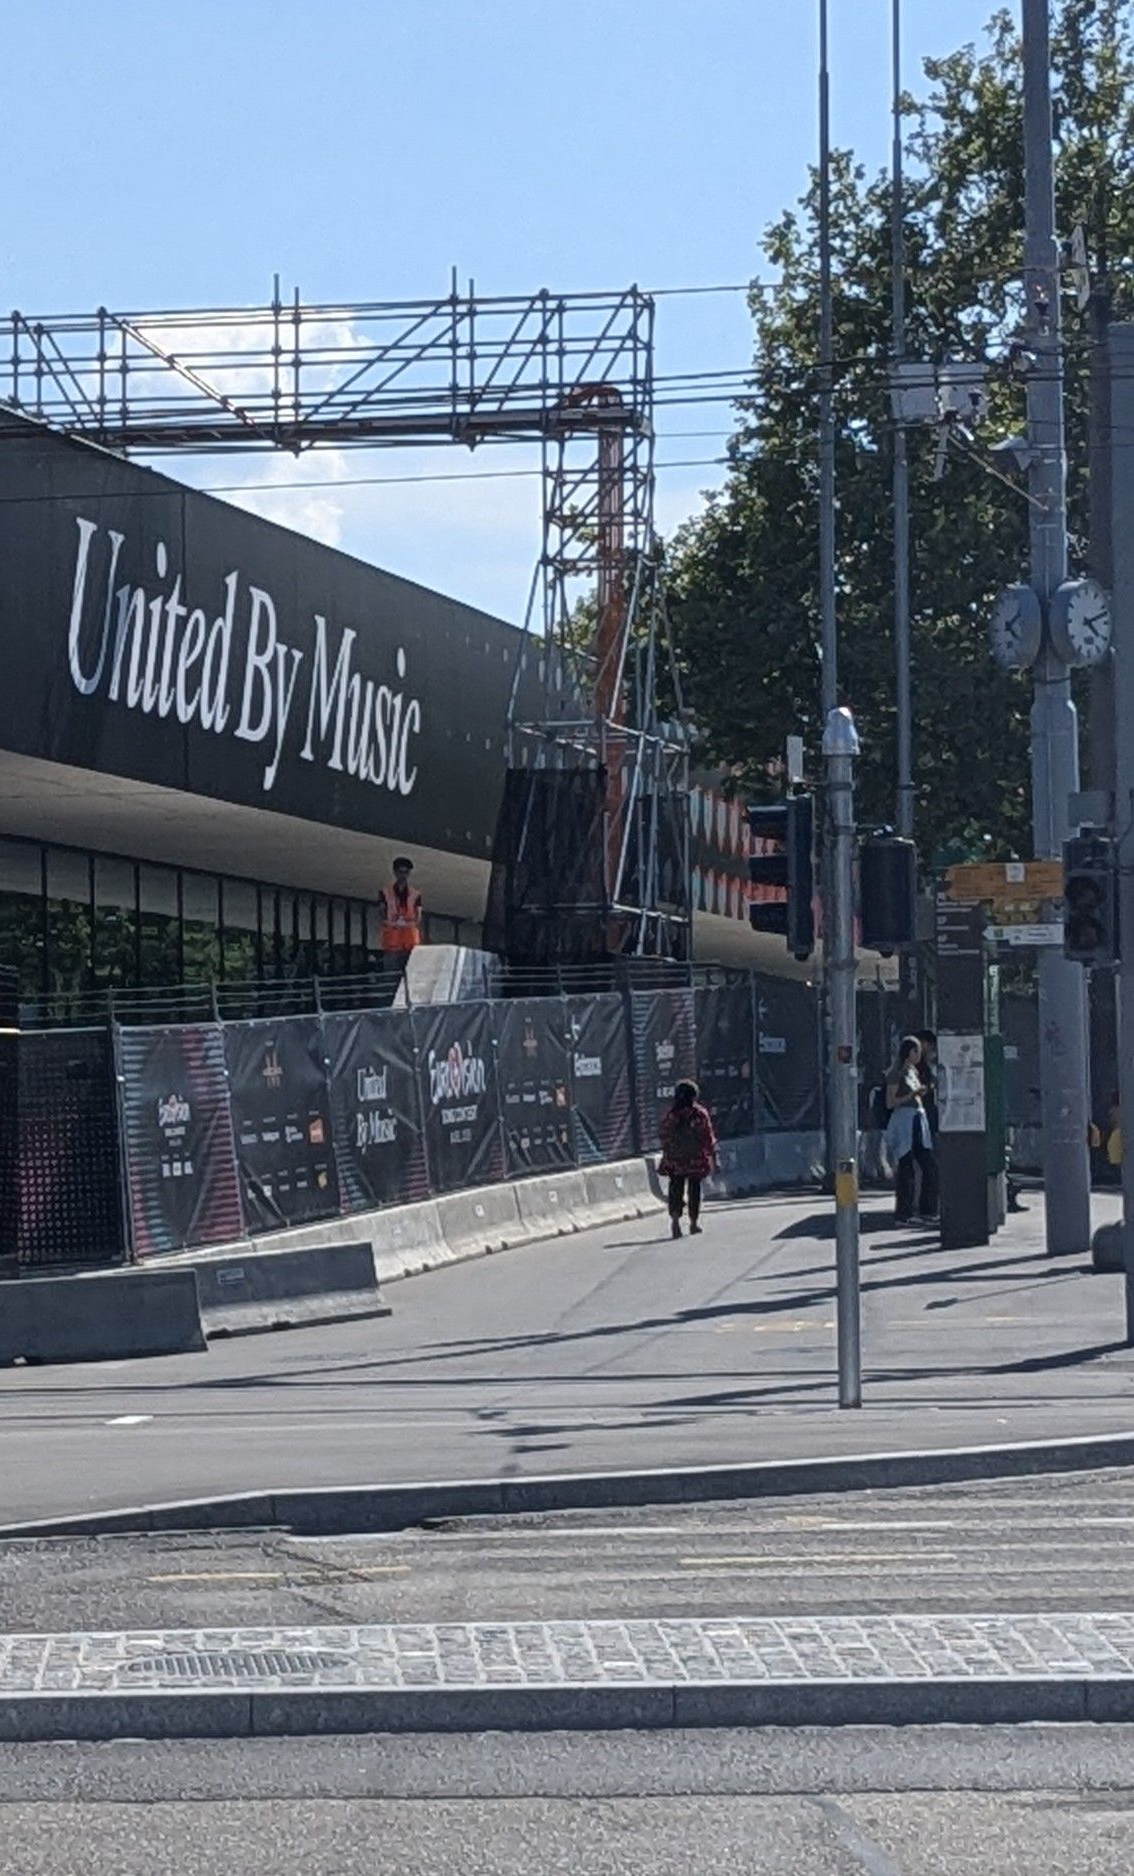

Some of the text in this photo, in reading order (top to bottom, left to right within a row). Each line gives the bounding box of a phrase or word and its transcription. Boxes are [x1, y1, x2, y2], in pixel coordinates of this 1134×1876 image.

[68, 516, 421, 796] United By Music
